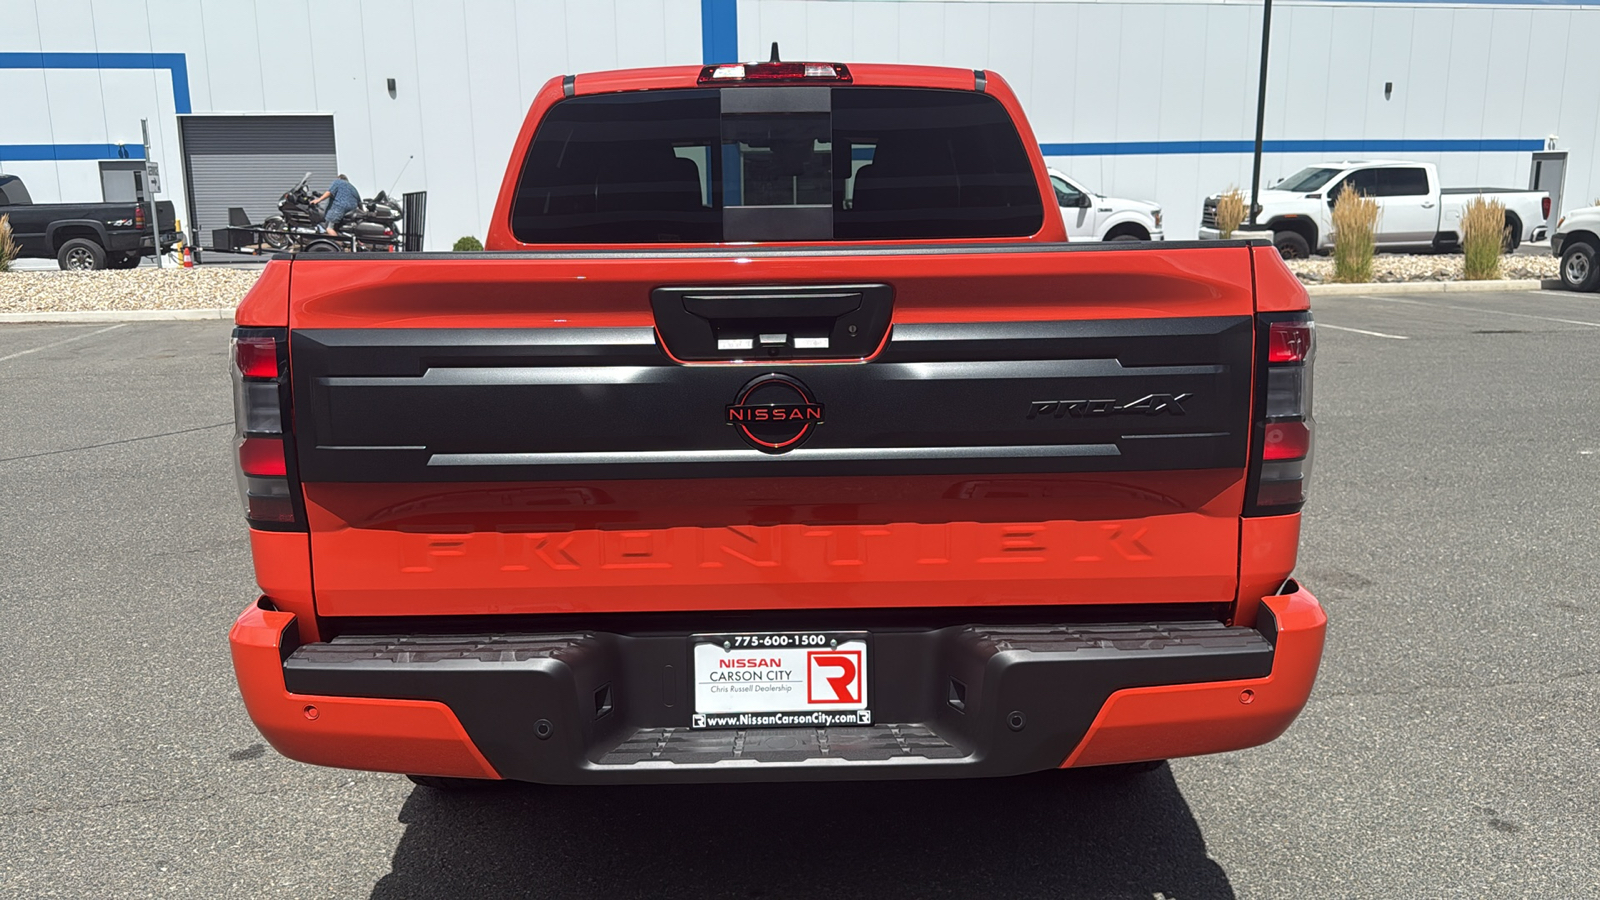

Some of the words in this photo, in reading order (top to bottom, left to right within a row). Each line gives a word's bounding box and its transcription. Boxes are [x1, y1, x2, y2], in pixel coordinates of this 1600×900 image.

[1026, 393, 1193, 419] PRO-4X
[729, 408, 821, 421] NISSAN
[399, 520, 1153, 572] FRONTIER
[734, 635, 826, 647] 775-600-1500
[719, 658, 782, 669] NISSAN
[709, 671, 763, 682] CARSON
[766, 670, 793, 681] CITY
[710, 685, 729, 694] Chris
[730, 684, 754, 693] Russell
[755, 683, 793, 694] Dealership
[707, 712, 857, 726] www.NissanCarsonCity.com
